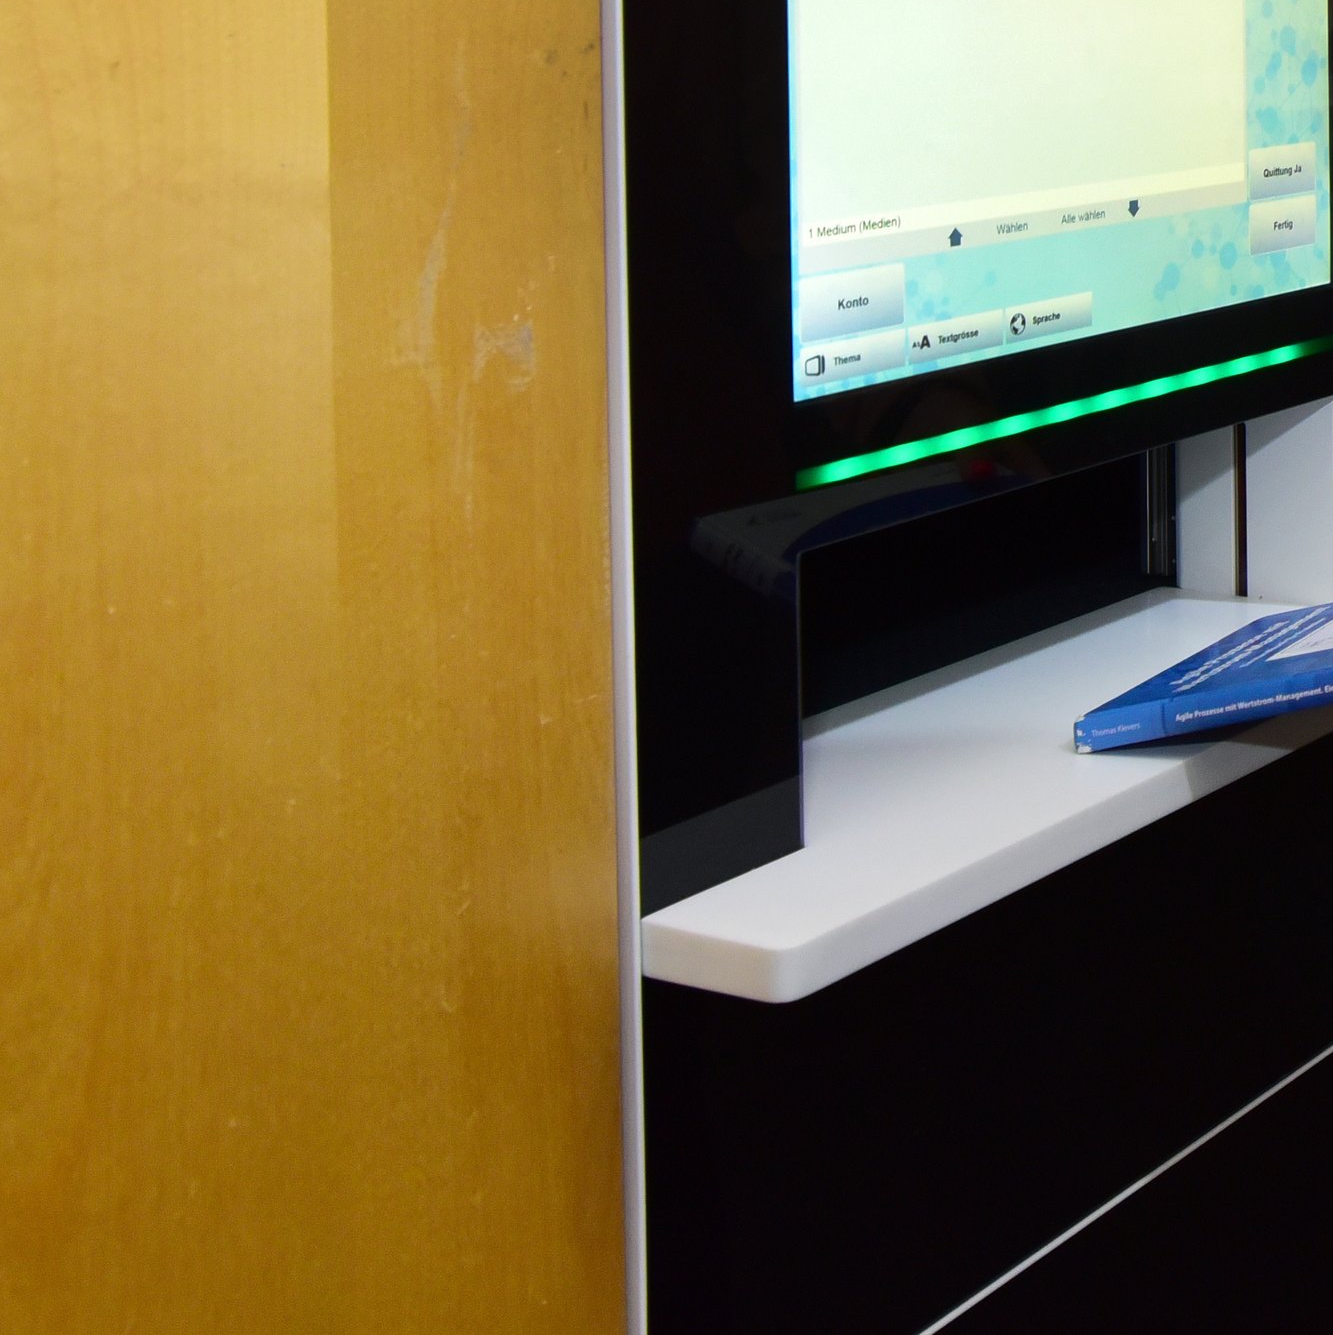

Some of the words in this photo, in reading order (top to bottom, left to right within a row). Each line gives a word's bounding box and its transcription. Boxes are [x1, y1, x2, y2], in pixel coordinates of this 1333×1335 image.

[1263, 167, 1293, 178] Quittung
[1294, 164, 1302, 173] Ja
[1061, 213, 1077, 226] Alle
[1077, 209, 1106, 223] wählen
[1273, 219, 1294, 231] Fertig
[808, 228, 814, 239] 1
[816, 224, 857, 238] Medium
[859, 217, 902, 234] (Medien)
[996, 220, 1029, 236] Wählen
[837, 295, 870, 311] Konto
[1032, 312, 1061, 326] Sprache
[938, 328, 980, 346] Textgrösse
[834, 352, 862, 367] Thema
[1175, 712, 1193, 723] Agile
[1194, 706, 1224, 719] Prozesse
[1225, 703, 1237, 713] mit
[1091, 727, 1117, 738] Thomas
